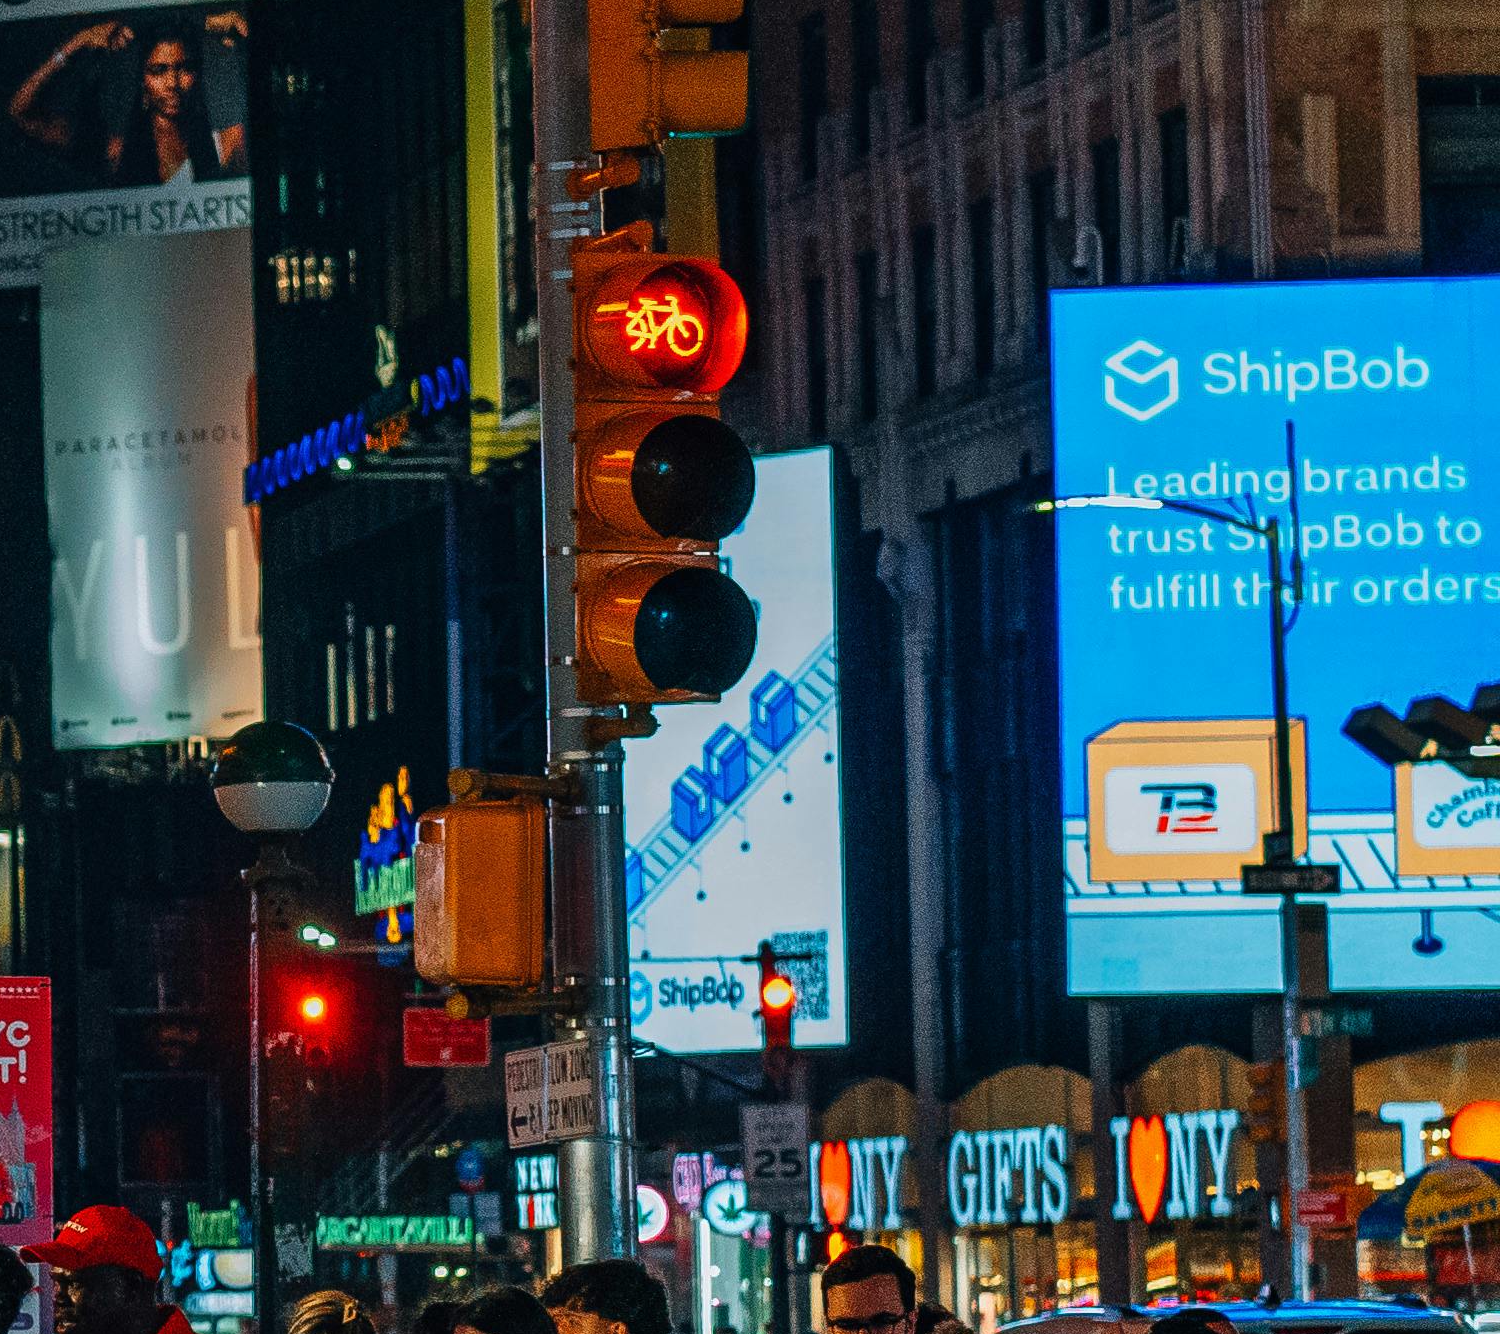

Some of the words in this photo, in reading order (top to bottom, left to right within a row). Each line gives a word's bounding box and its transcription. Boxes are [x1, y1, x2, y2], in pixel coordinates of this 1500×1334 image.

[147, 193, 250, 232] STARTS
[1202, 342, 1431, 403] ShipBob
[1107, 461, 1292, 504] Leading
[1303, 454, 1467, 494] brands
[1107, 523, 1215, 554] trust
[1437, 515, 1482, 545] to
[1110, 572, 1221, 611] fulfill
[753, 1148, 802, 1178] 25
[848, 1136, 908, 1230] NY
[947, 1124, 1069, 1227] GIFTS
[1110, 1115, 1132, 1220] I
[1164, 1108, 1241, 1219] NY
